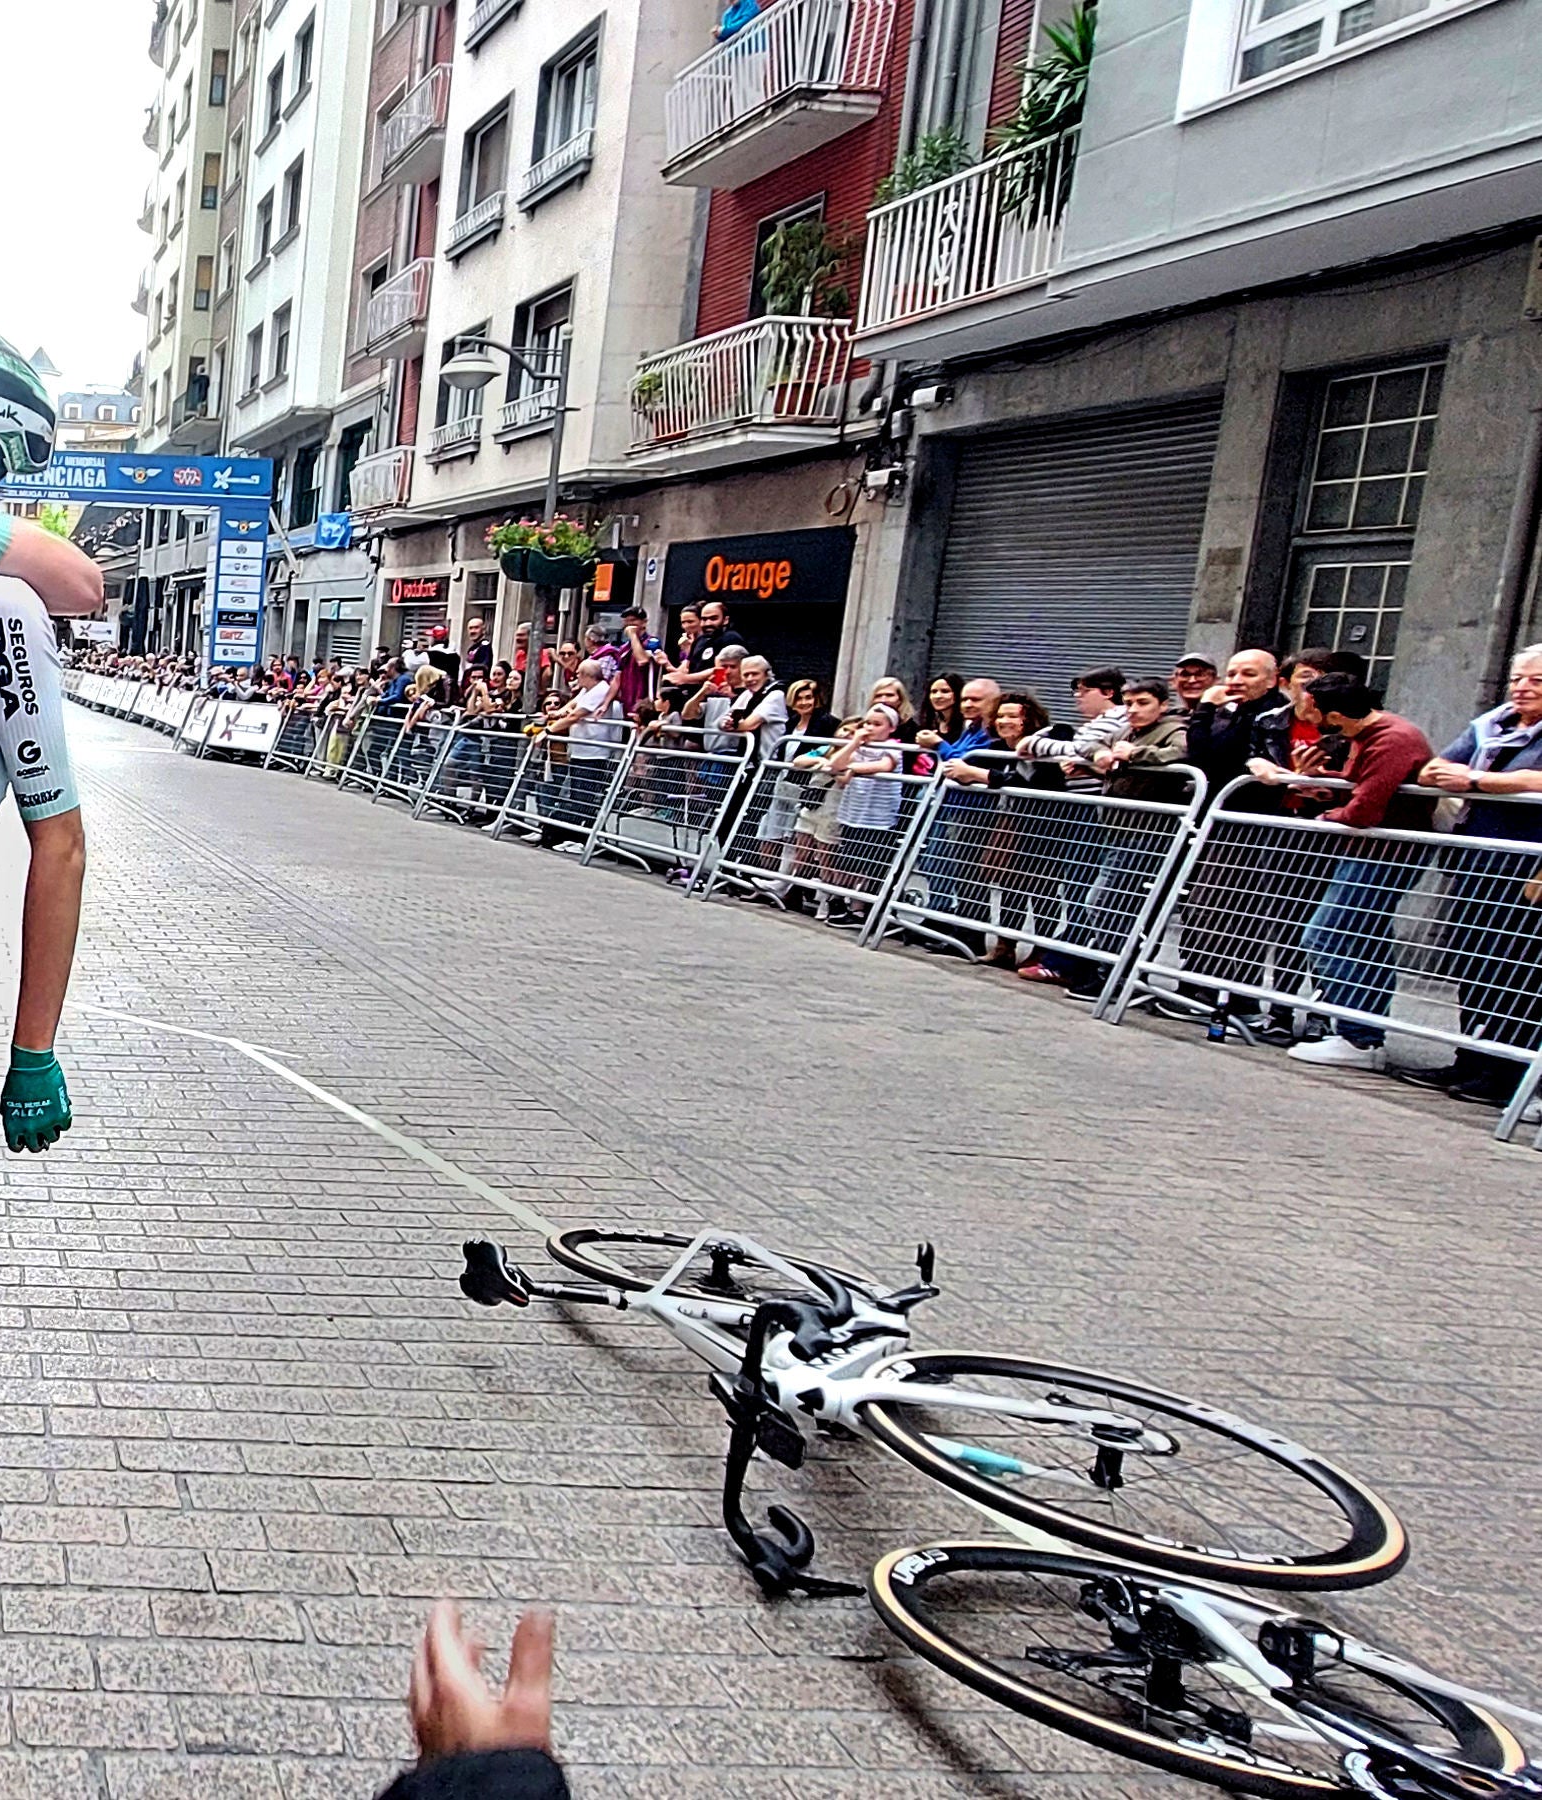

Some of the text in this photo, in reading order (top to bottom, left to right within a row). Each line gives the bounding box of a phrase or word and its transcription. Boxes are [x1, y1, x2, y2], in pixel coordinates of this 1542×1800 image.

[64, 456, 106, 467] MEMORIAL
[705, 555, 792, 598] Orange
[403, 578, 438, 598] vodafone
[7, 617, 39, 716] SEGUROS
[11, 1107, 45, 1117] ALEA
